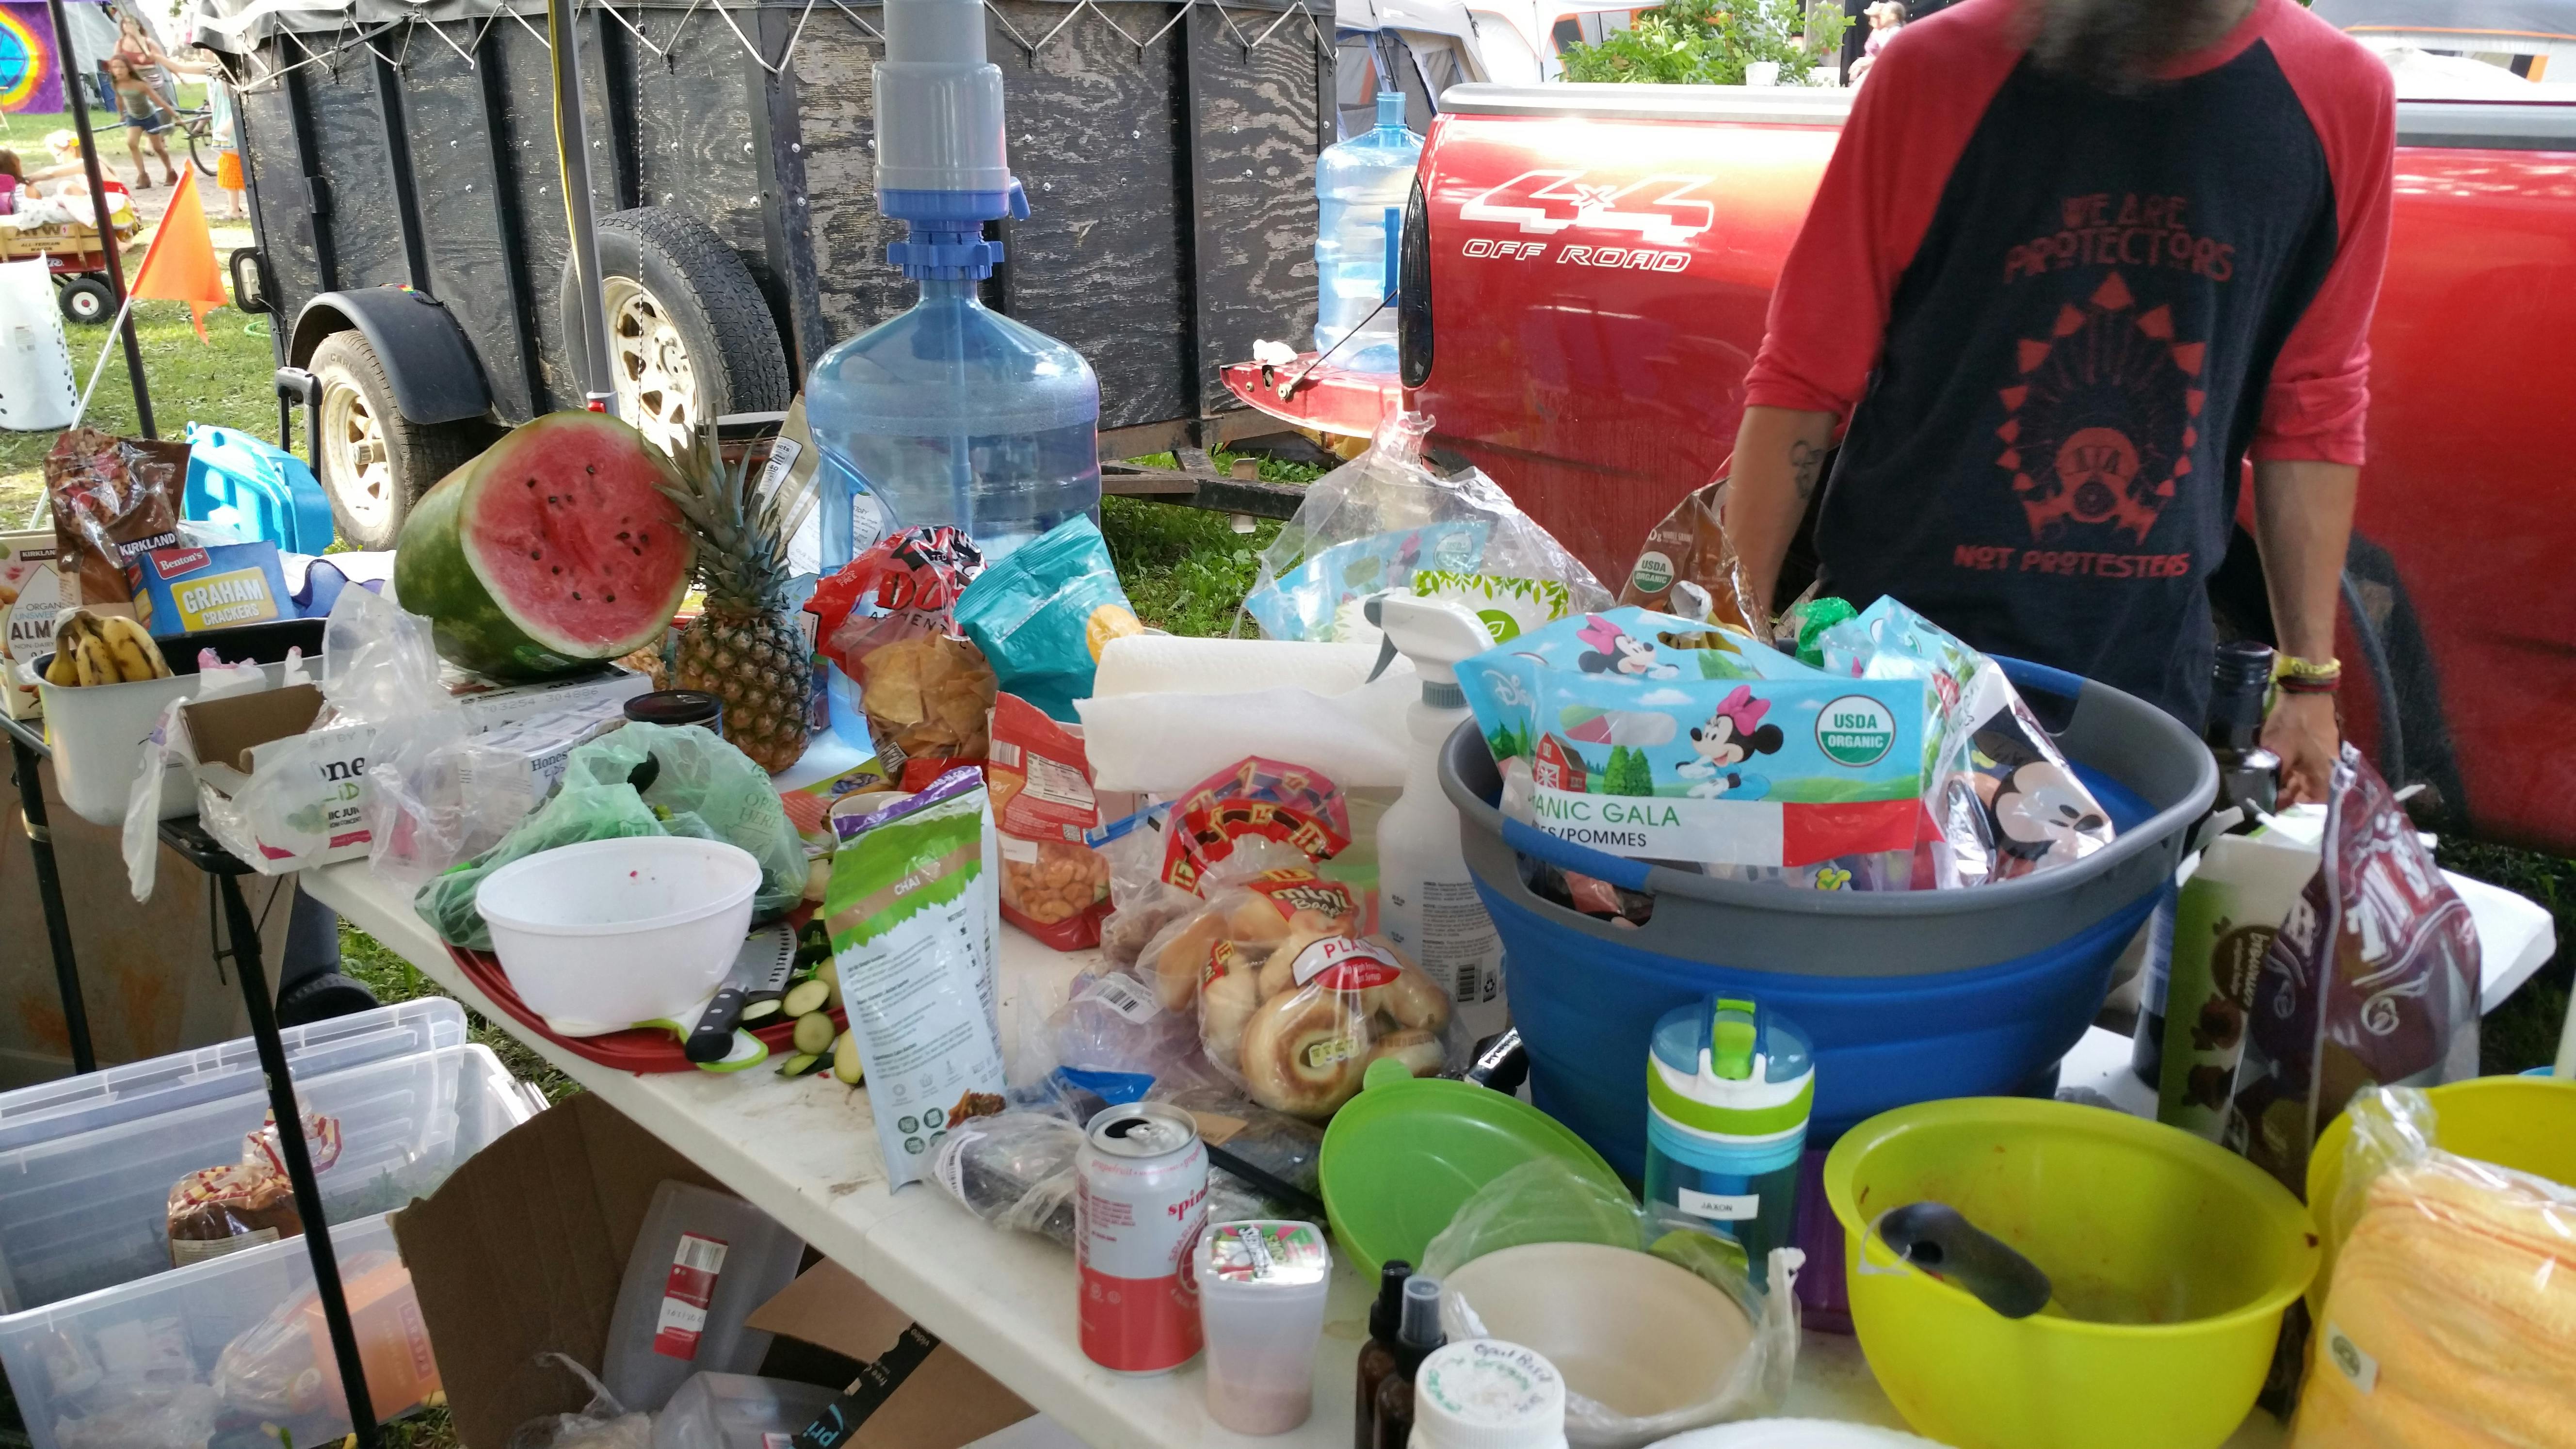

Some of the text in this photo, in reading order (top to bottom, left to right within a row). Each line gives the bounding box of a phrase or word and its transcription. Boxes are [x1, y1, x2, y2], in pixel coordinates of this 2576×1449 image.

[2063, 193, 2186, 229] WE ARE
[1462, 238, 1692, 272] OFF ROAD
[2003, 225, 2235, 284] PROTECTORS
[119, 533, 176, 556] KIRKLAND
[160, 551, 203, 571] Benton's
[1641, 560, 1666, 573] USDA
[1954, 545, 2191, 578] NOT PROTESTERS
[840, 573, 857, 588] FREE
[1635, 572, 1668, 584] ORGANIC
[182, 579, 264, 613] GRAHAM
[202, 603, 260, 626] CRACKERS
[14, 641, 54, 650] NON-DAIRY
[1834, 713, 1877, 728] USDA
[337, 732, 355, 742] BY
[1827, 734, 1884, 748] ORGANIC
[1602, 803, 1680, 826] GALA
[894, 877, 920, 896] CHAI
[1270, 885, 1353, 908] mini
[1324, 940, 1379, 959] PLAIN
[1701, 1202, 1733, 1211] JAXON
[911, 1329, 930, 1347] video
